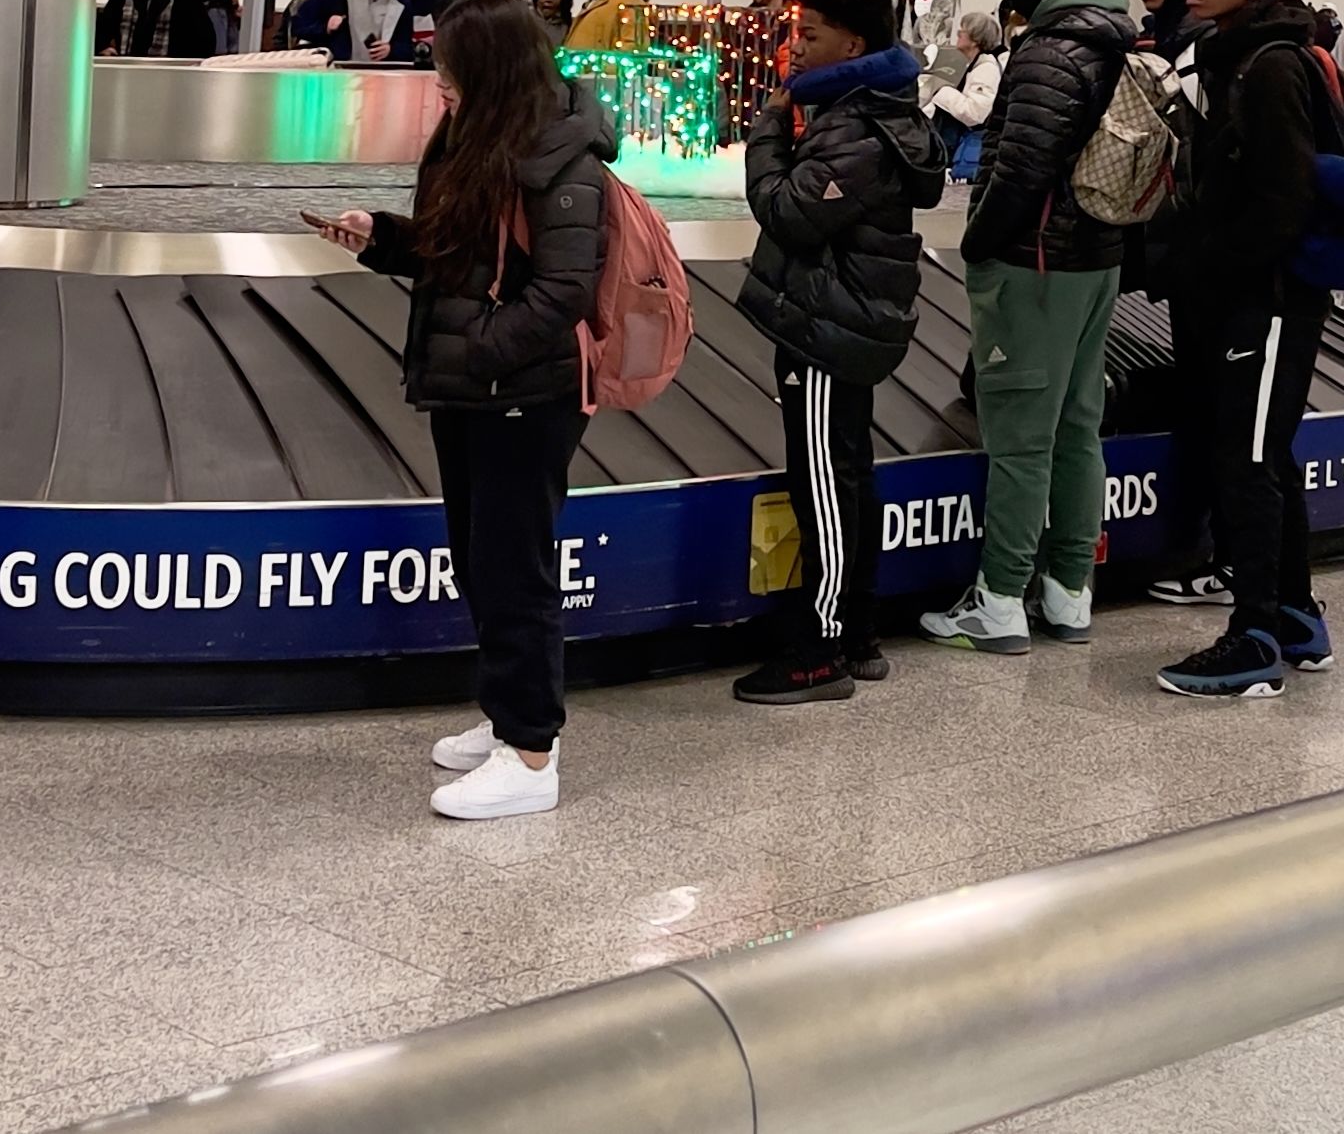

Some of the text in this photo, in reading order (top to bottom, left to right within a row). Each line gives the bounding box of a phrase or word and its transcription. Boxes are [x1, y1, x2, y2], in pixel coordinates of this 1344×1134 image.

[54, 551, 242, 610] COULD
[258, 550, 349, 608] FLY
[361, 547, 460, 605] FOR
[561, 593, 595, 610] APPLY
